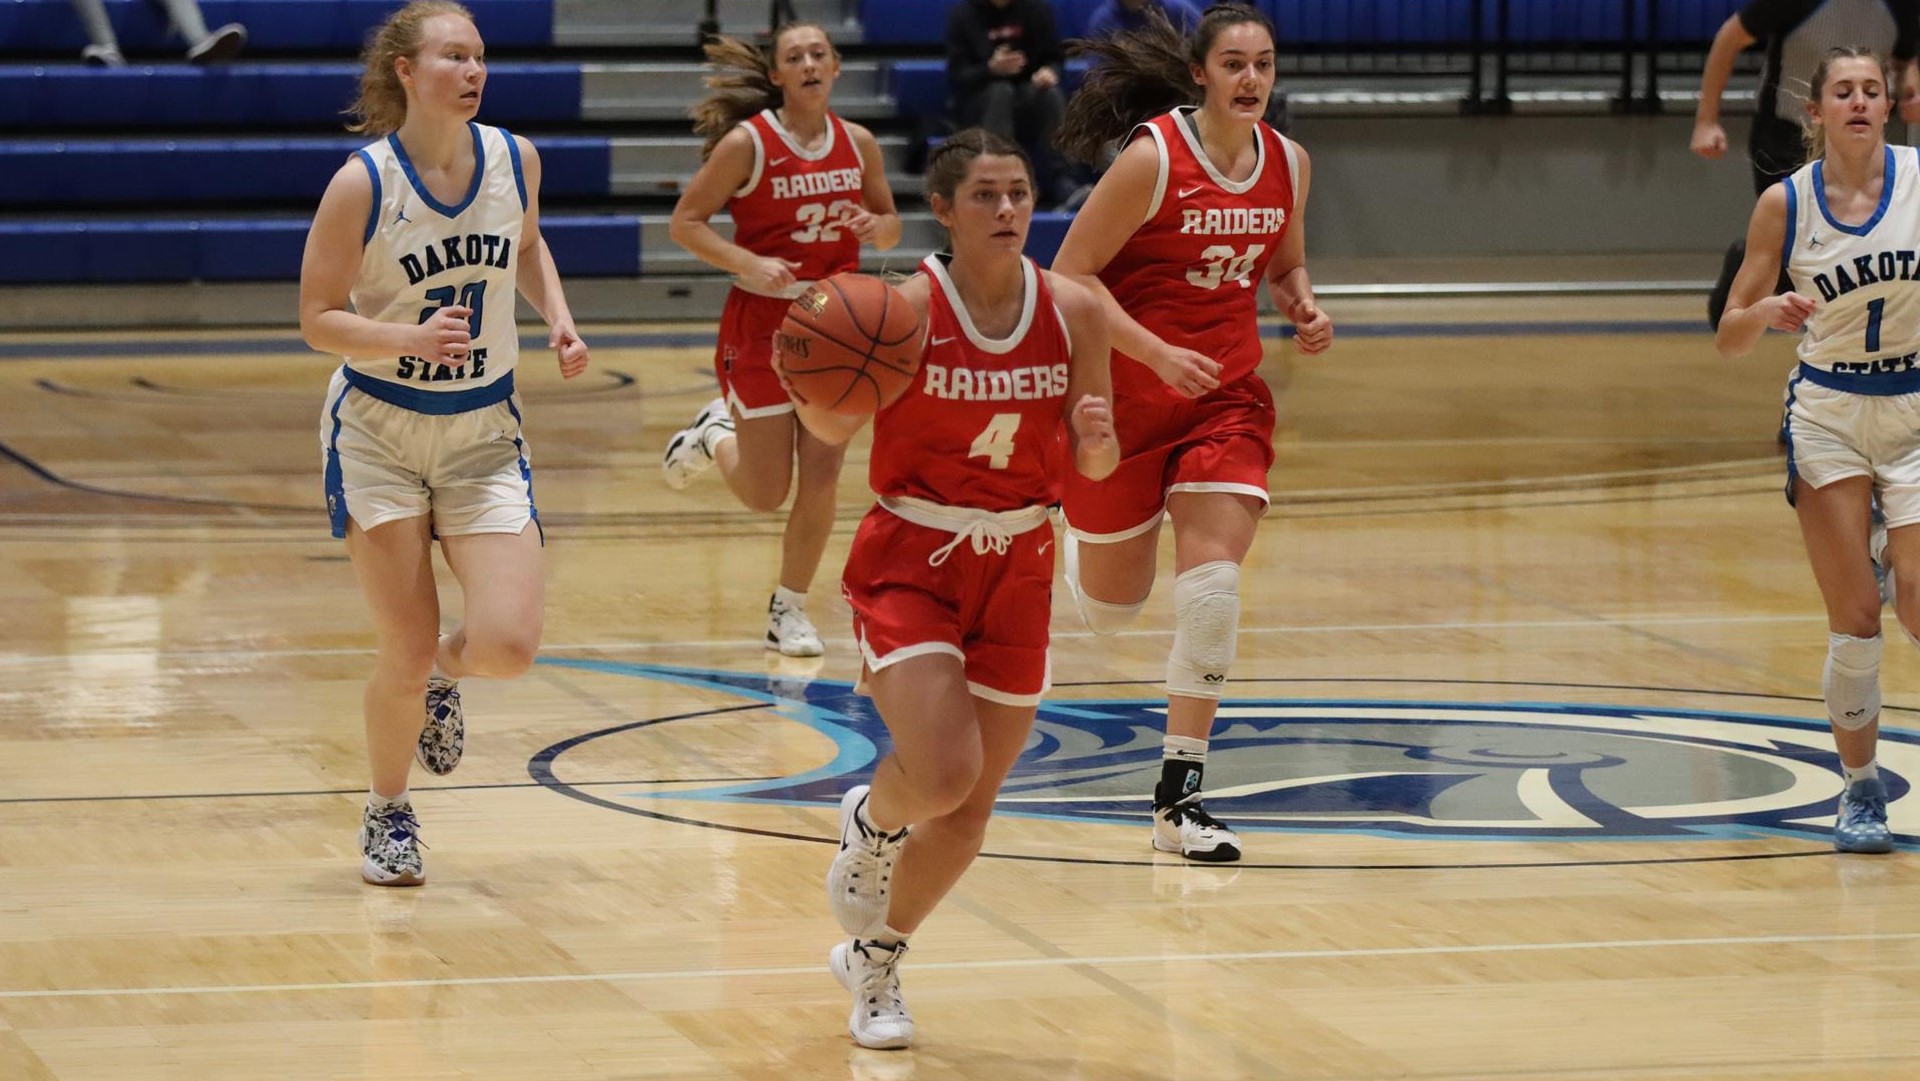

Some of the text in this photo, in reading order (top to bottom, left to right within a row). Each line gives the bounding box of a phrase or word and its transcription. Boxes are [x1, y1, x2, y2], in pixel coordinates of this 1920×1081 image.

[770, 167, 861, 199] RAIDERS
[790, 199, 853, 243] 32
[1181, 208, 1285, 235] RAIDERS
[399, 234, 511, 286] DAKOTA
[1185, 244, 1266, 290] 34
[1865, 297, 1886, 352] 1
[923, 363, 1069, 401] RAIDERS
[967, 413, 1022, 469] 4
